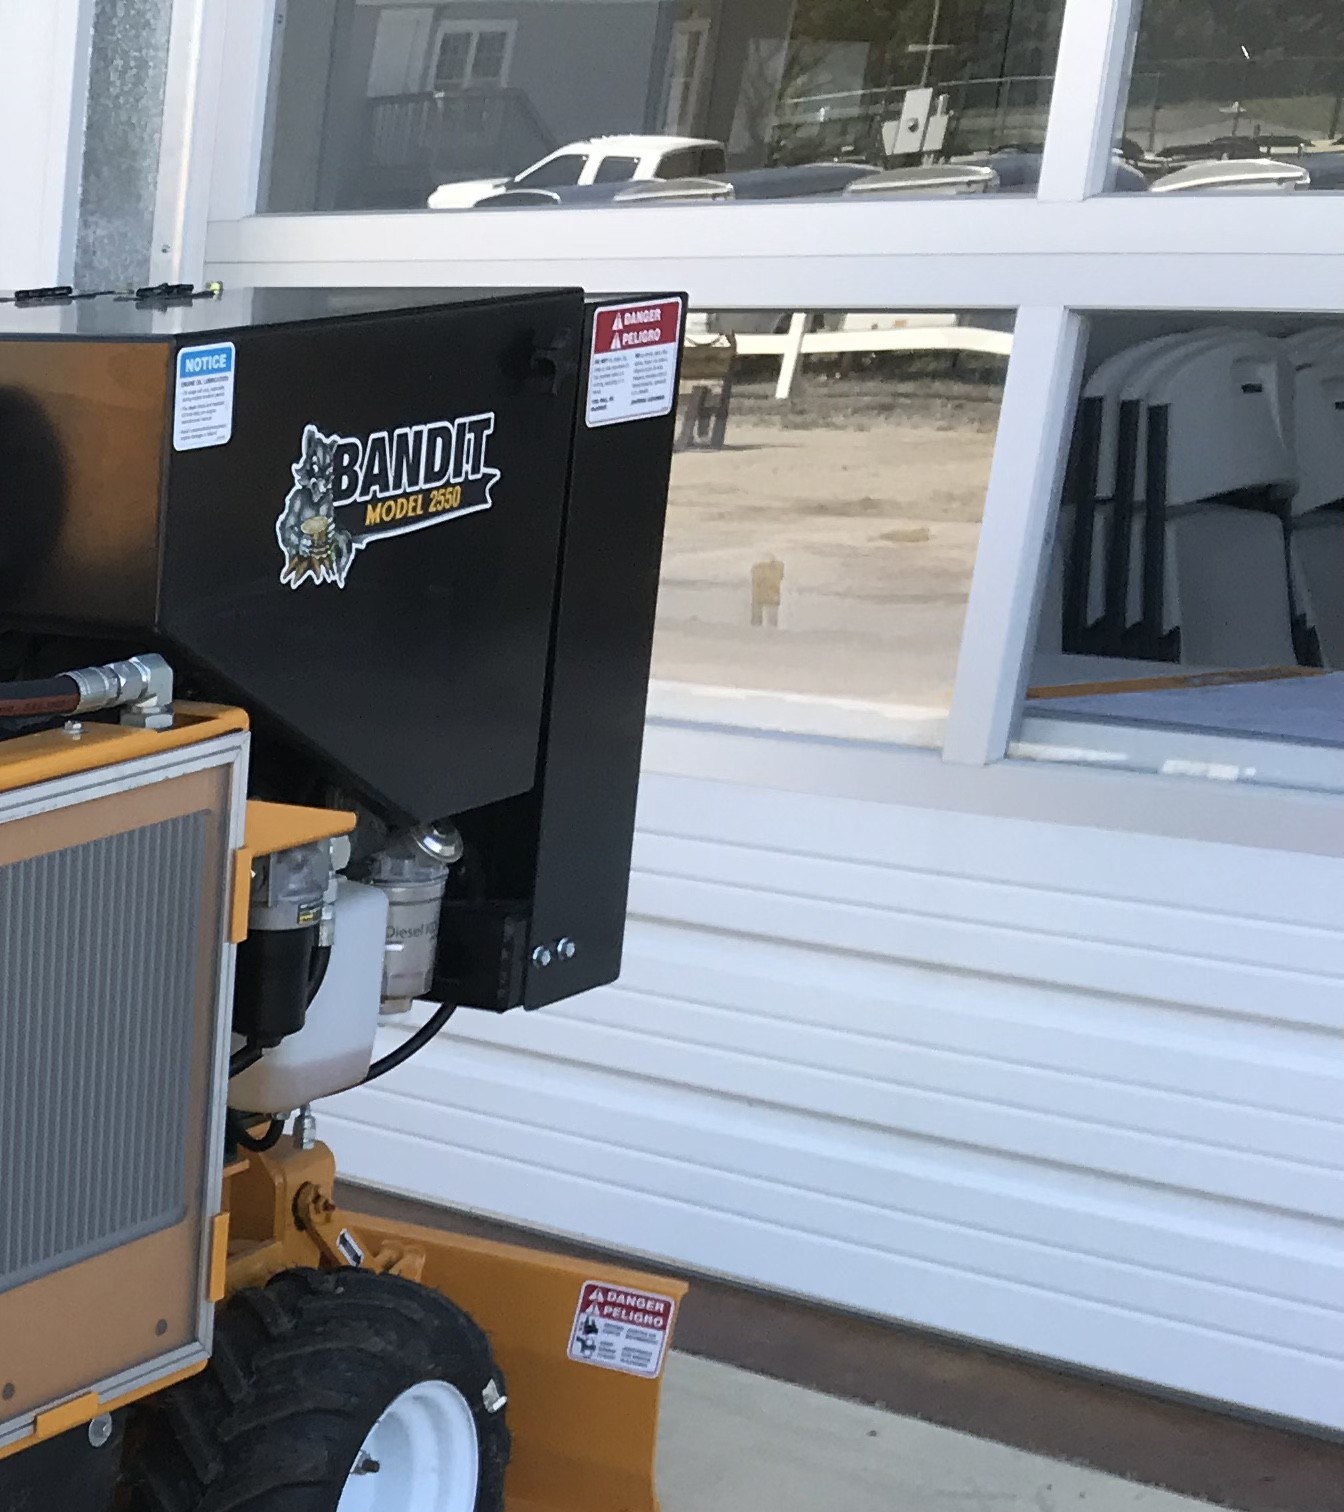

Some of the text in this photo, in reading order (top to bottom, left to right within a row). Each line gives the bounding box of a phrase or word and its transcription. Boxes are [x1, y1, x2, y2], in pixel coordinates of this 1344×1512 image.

[624, 309, 661, 326] DANGER
[622, 328, 661, 346] PELIGRO
[185, 353, 227, 373] NOTICE
[332, 413, 494, 506] BANDIT
[365, 486, 461, 526] MODEL 2550
[606, 1290, 665, 1313] DANGER
[603, 1305, 663, 1327] PELIGRO
